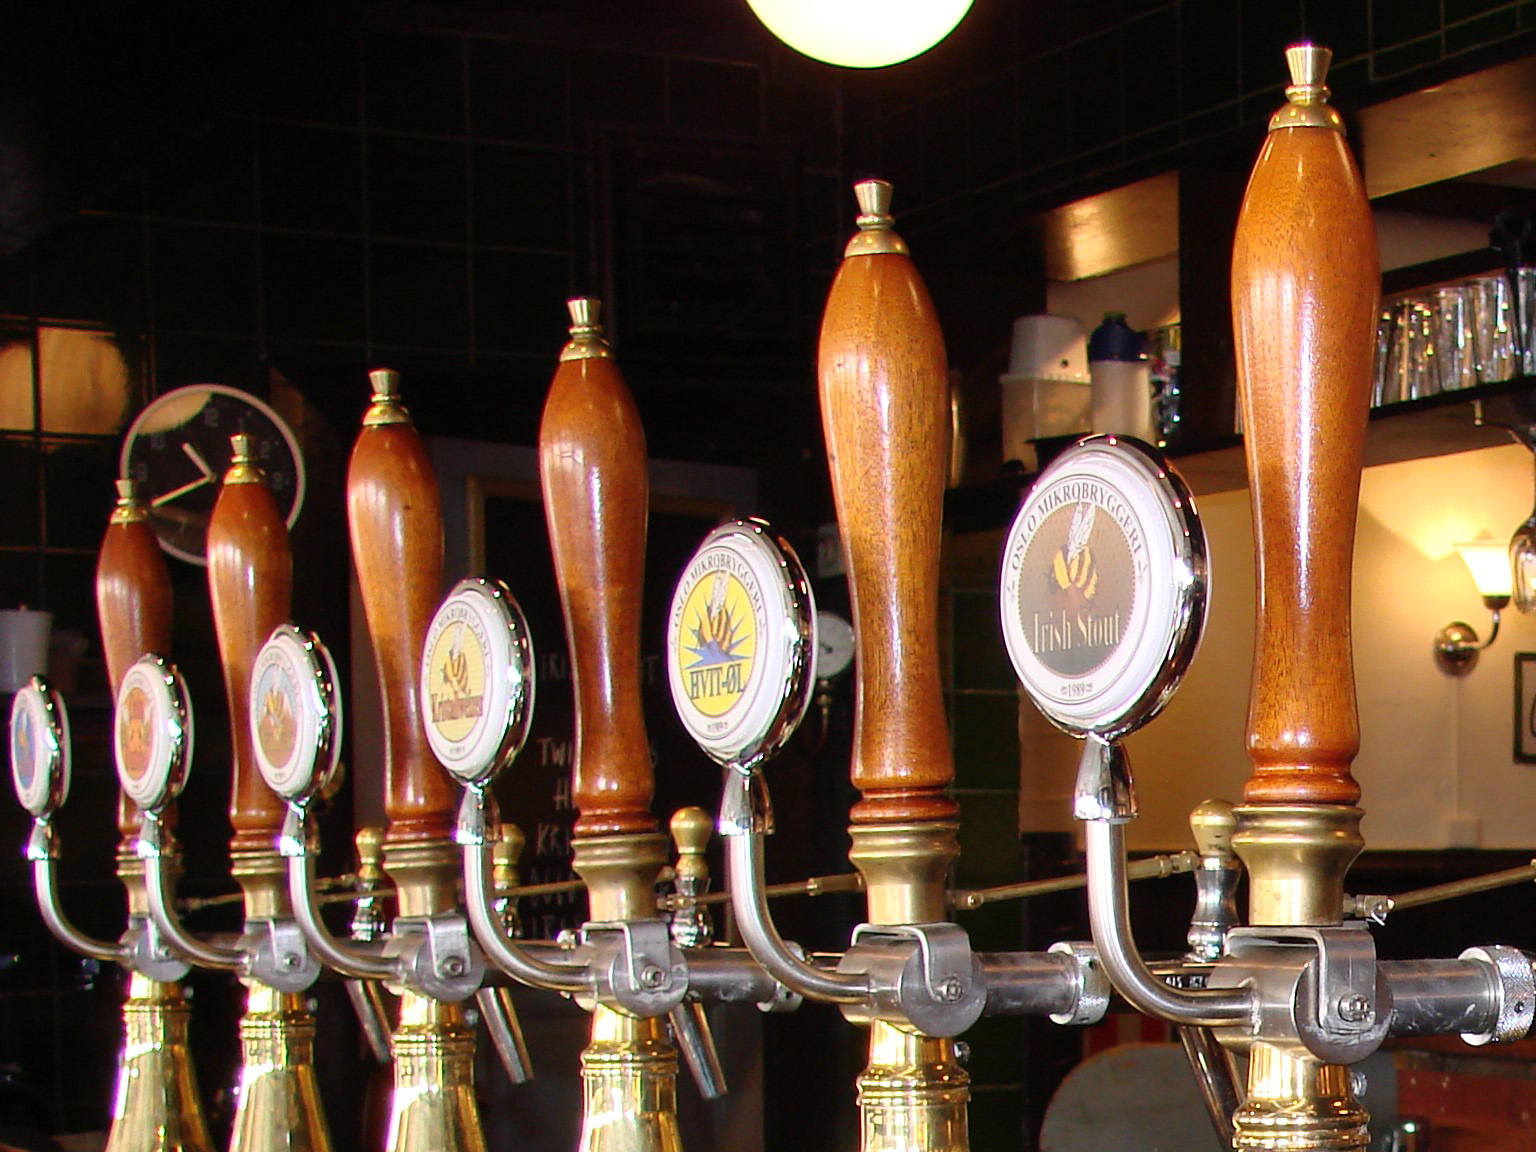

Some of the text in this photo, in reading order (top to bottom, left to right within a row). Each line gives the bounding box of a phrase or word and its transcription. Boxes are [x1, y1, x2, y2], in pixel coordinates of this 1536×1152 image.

[1011, 482, 1142, 571] OSLO MIKROBRYGGERI
[1032, 609, 1120, 653] Irish Stout
